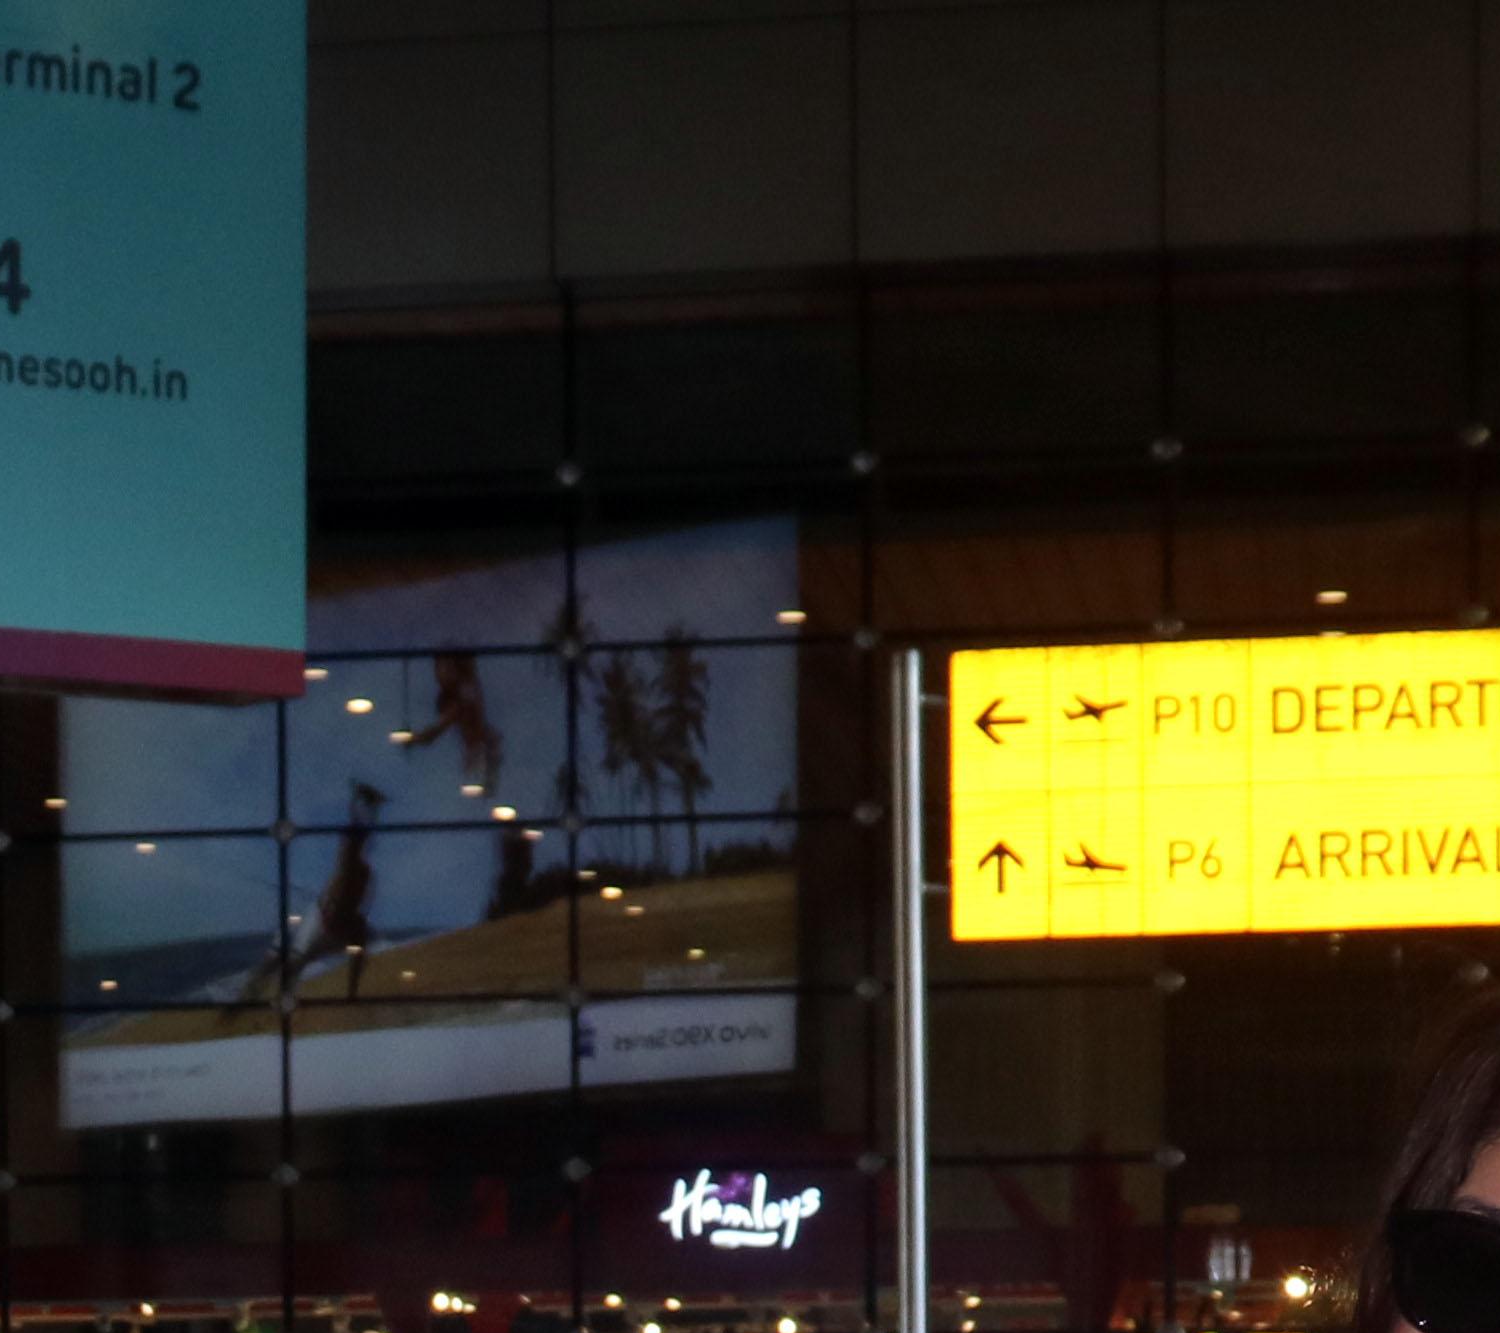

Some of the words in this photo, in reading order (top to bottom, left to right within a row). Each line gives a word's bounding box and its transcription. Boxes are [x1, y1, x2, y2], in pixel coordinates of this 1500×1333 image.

[172, 61, 201, 112] 2
[1153, 692, 1236, 735] P10
[1167, 839, 1223, 881] P6
[657, 1168, 822, 1250] Hamleys
